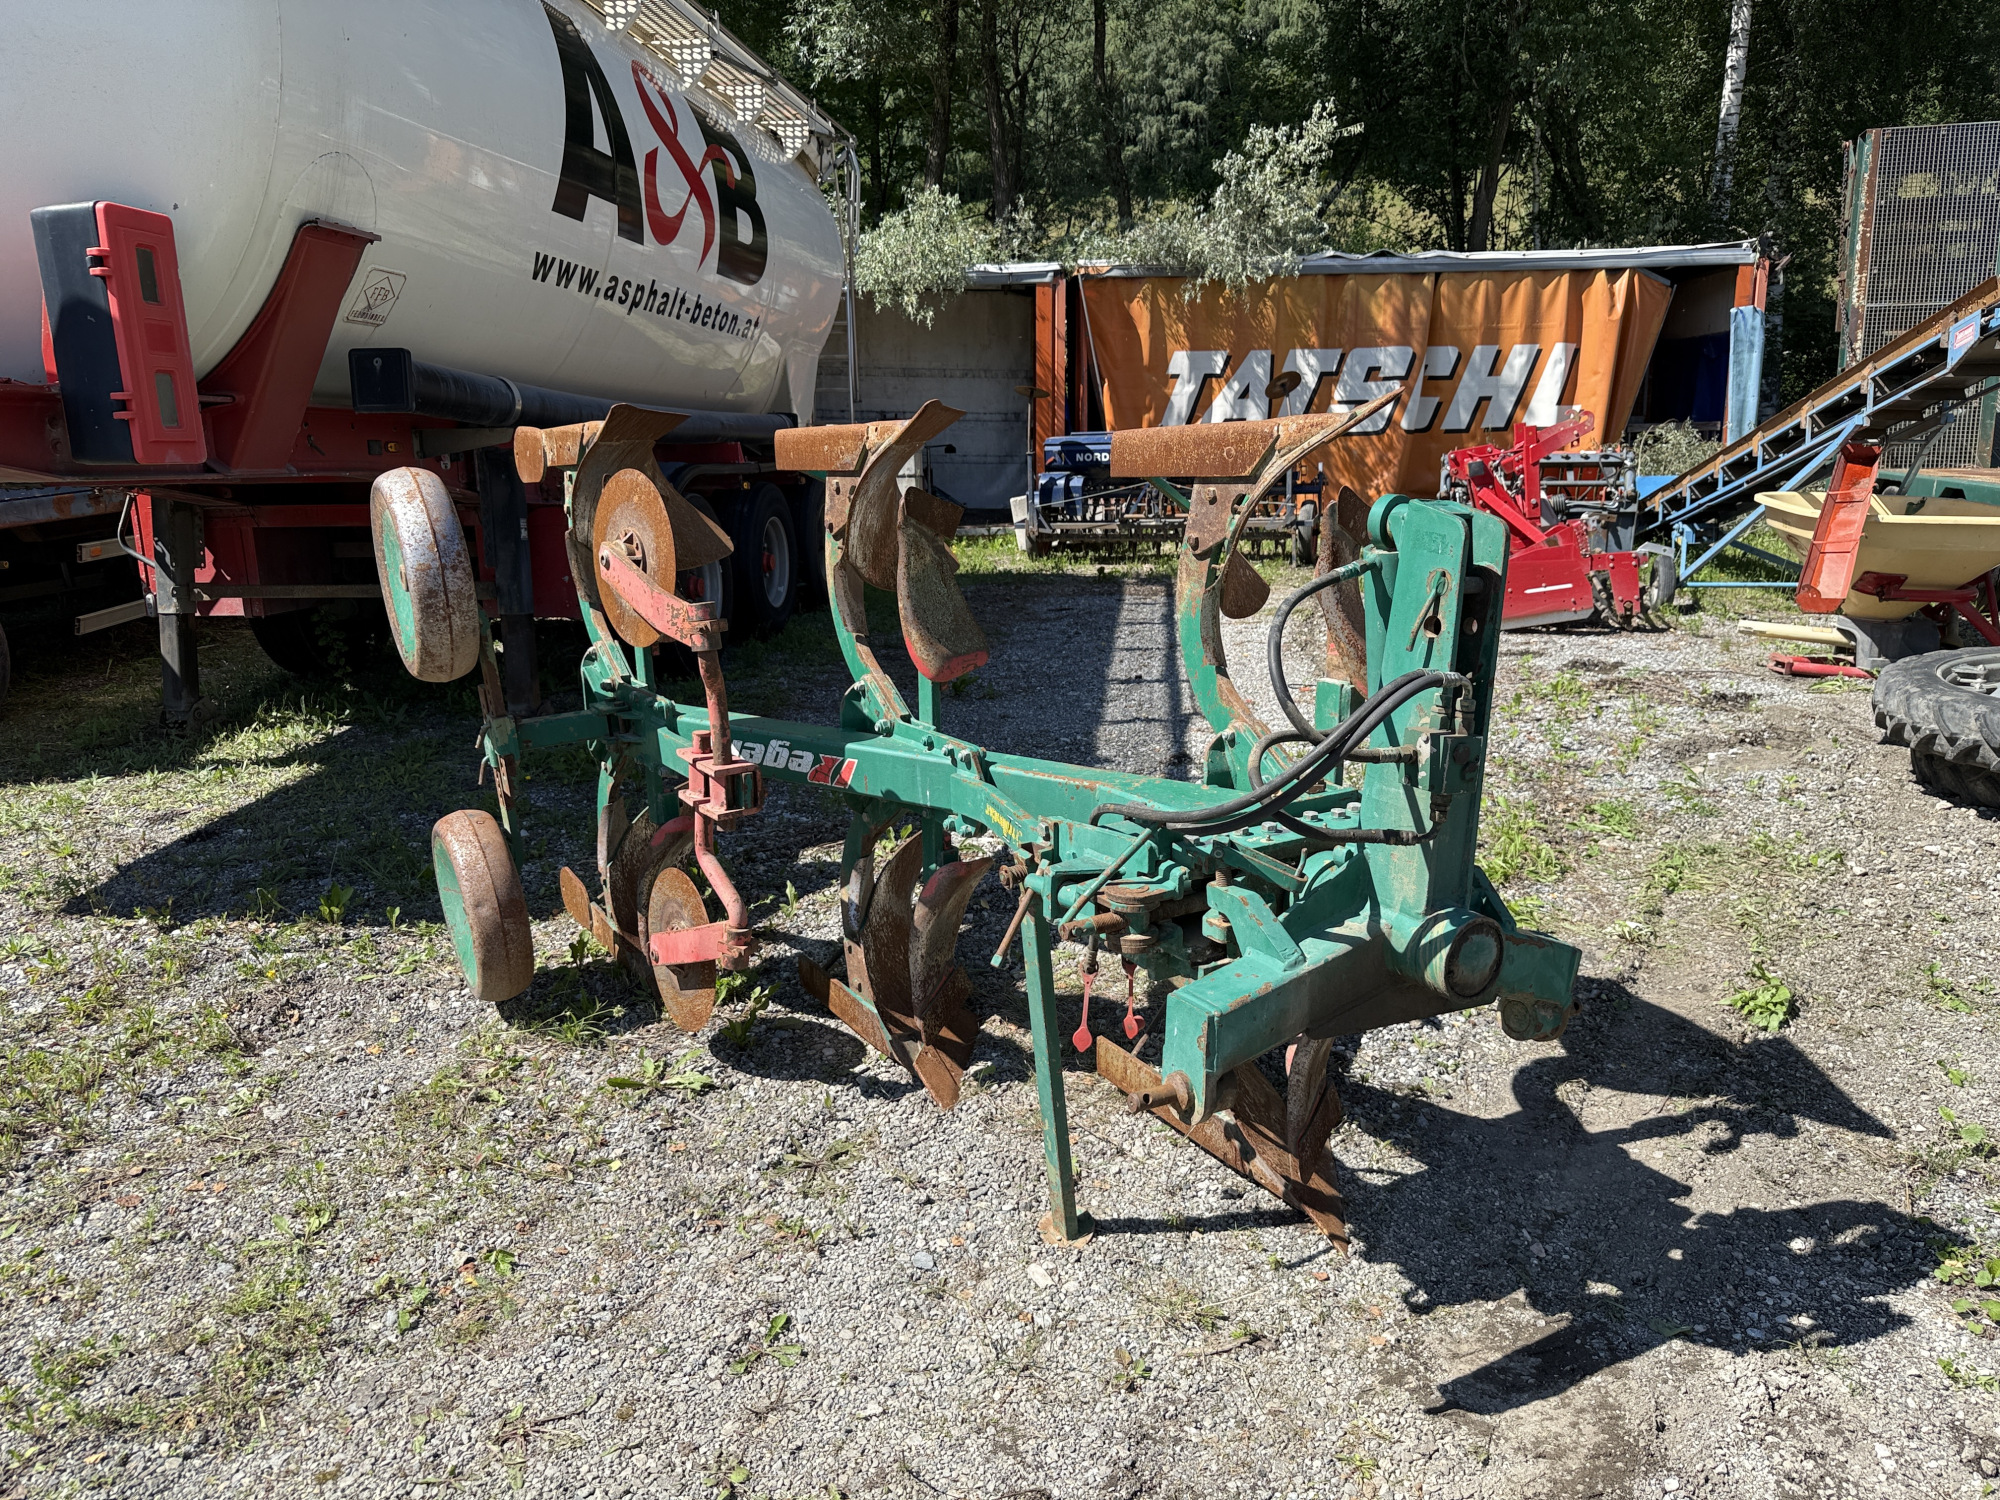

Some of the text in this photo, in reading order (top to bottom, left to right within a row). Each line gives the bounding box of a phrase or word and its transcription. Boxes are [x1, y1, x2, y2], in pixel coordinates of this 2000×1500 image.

[540, 0, 768, 286] A&B
[369, 287, 390, 305] FFB
[532, 251, 760, 341] www.asphalt-beton.at
[1159, 342, 1582, 436] TATSCHL
[1076, 453, 1111, 462] NORD
[730, 738, 858, 789] Rege
